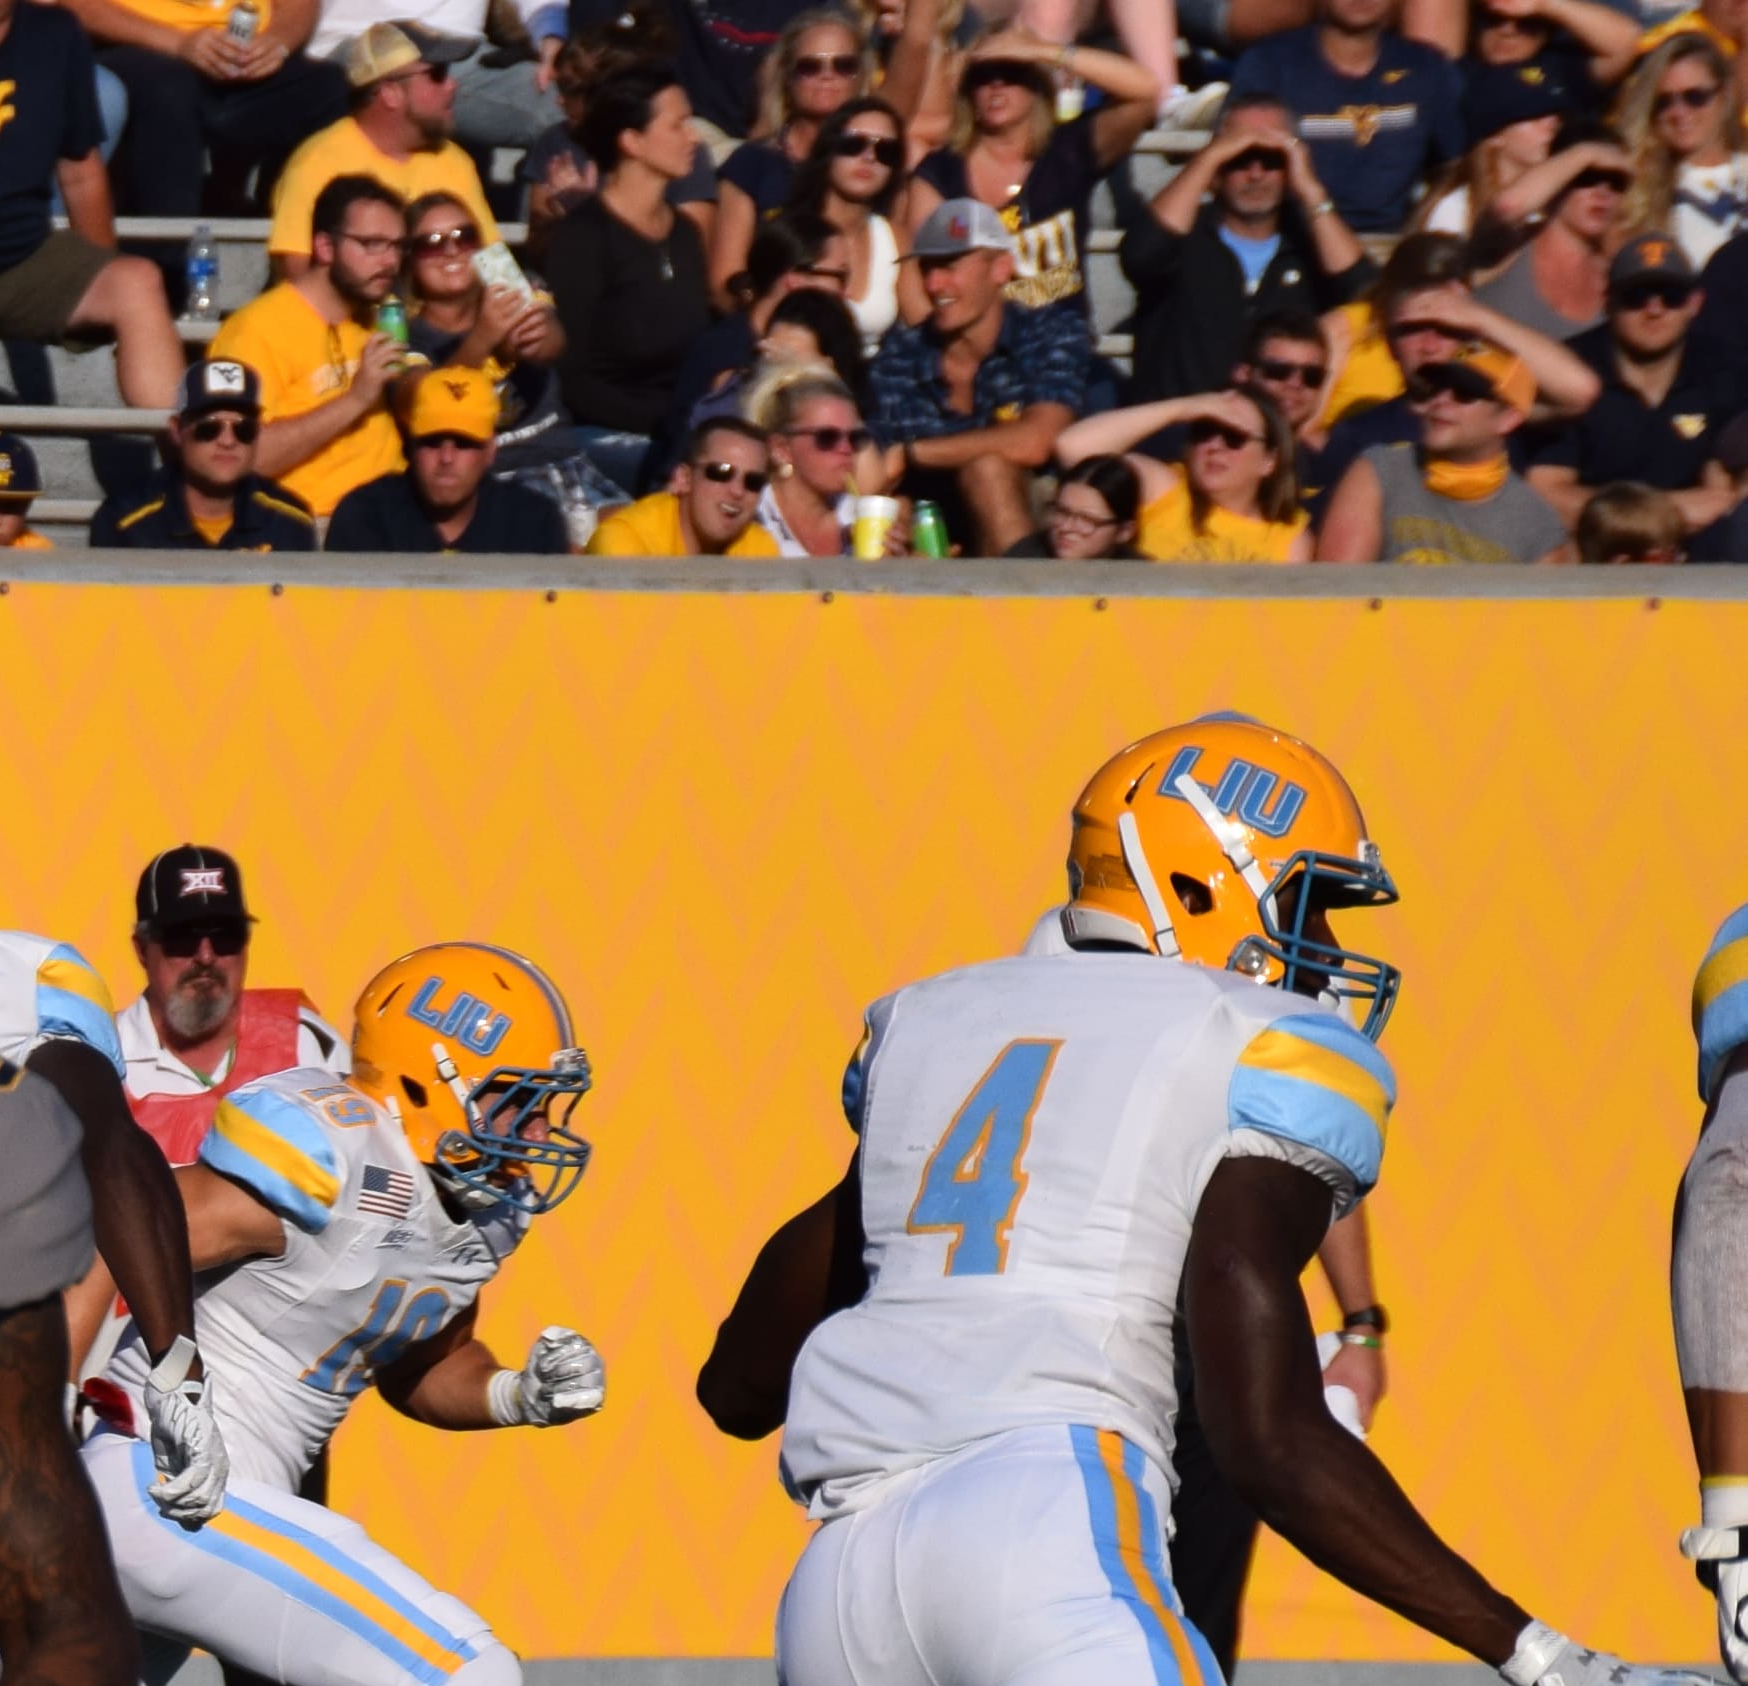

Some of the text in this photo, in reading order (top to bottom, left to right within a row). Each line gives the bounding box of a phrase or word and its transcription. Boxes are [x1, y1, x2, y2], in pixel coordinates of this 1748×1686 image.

[1157, 746, 1307, 839] LIU
[406, 975, 513, 1057] LIU
[906, 1037, 1065, 1278] 4
